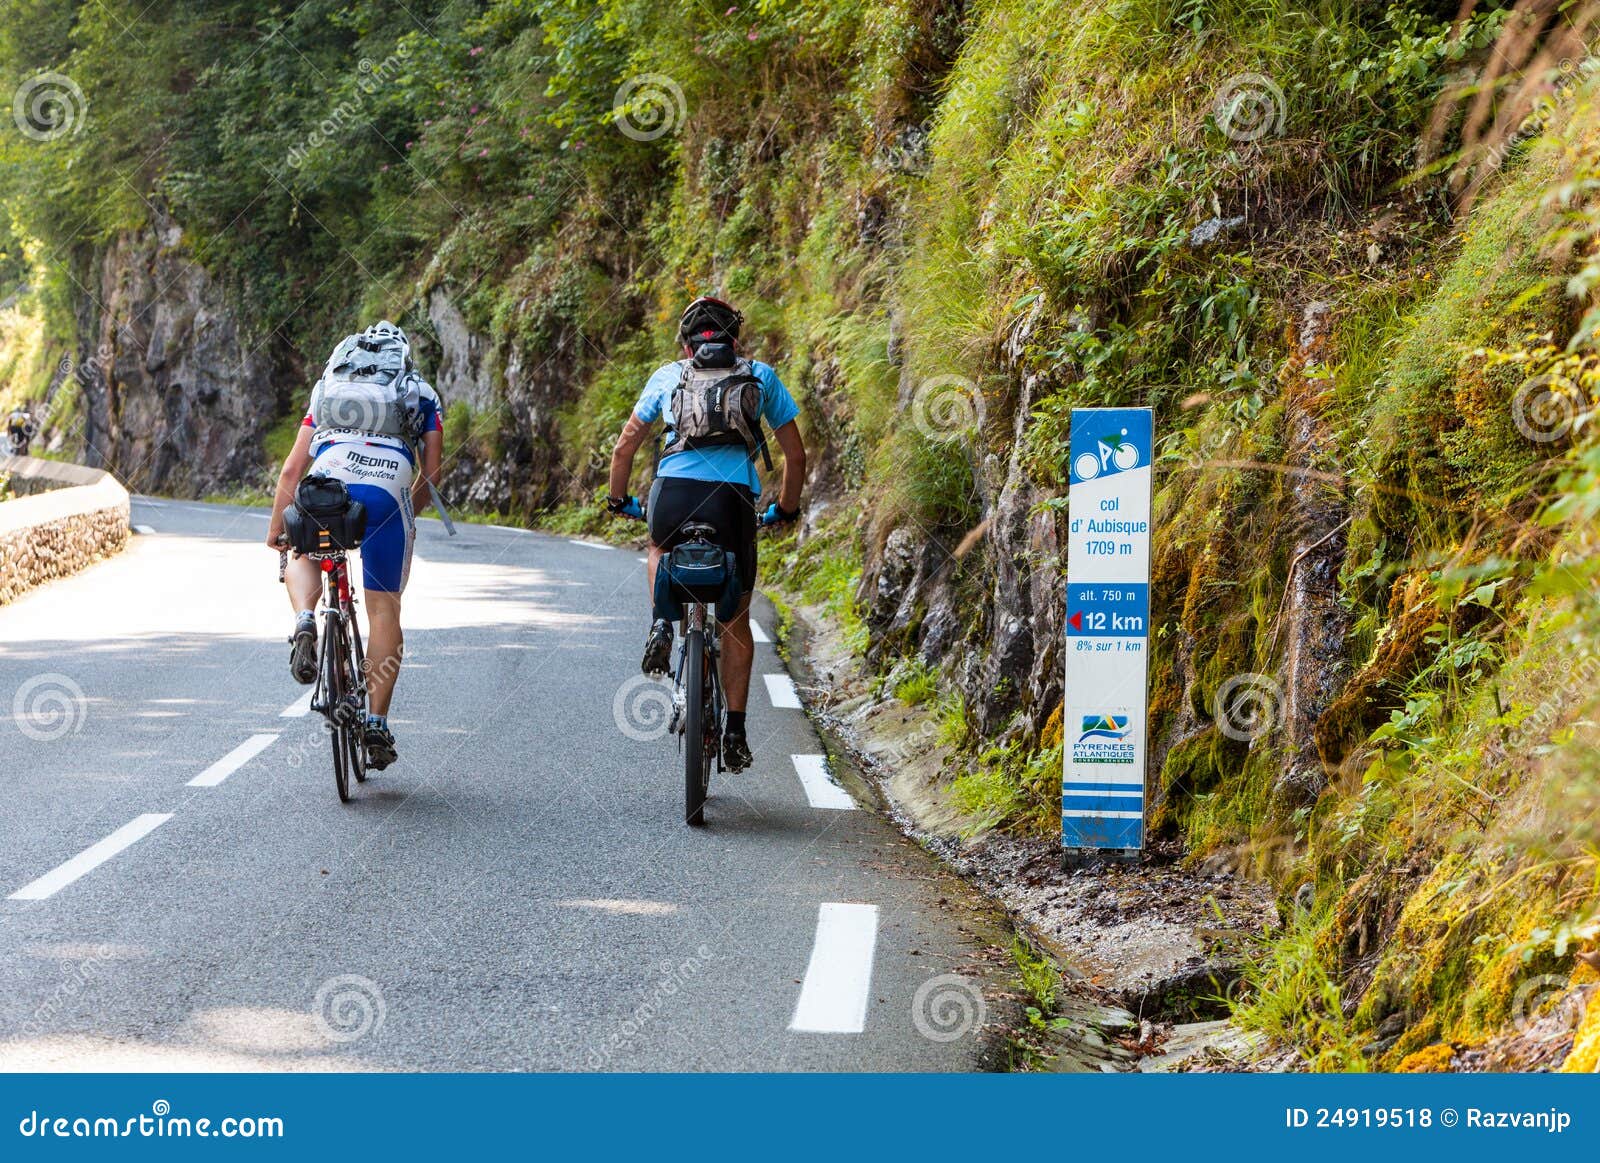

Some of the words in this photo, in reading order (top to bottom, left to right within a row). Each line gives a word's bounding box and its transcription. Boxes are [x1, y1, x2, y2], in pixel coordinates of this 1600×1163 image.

[346, 450, 399, 471] MEDINA
[342, 463, 396, 480] Llagostera
[1100, 496, 1119, 511] col
[1071, 518, 1083, 533] d'
[1087, 518, 1147, 536] Aubisque
[1086, 540, 1115, 555] 1709
[1120, 543, 1132, 555] m
[1080, 590, 1097, 601] alt.
[1102, 590, 1122, 601] 750
[1126, 592, 1136, 601] m
[1085, 611, 1106, 630] 12
[1112, 611, 1143, 631] km
[1076, 640, 1093, 652] 8%
[1095, 642, 1113, 652] sur
[1125, 641, 1141, 652] km
[1073, 743, 1135, 751] PYRENEES
